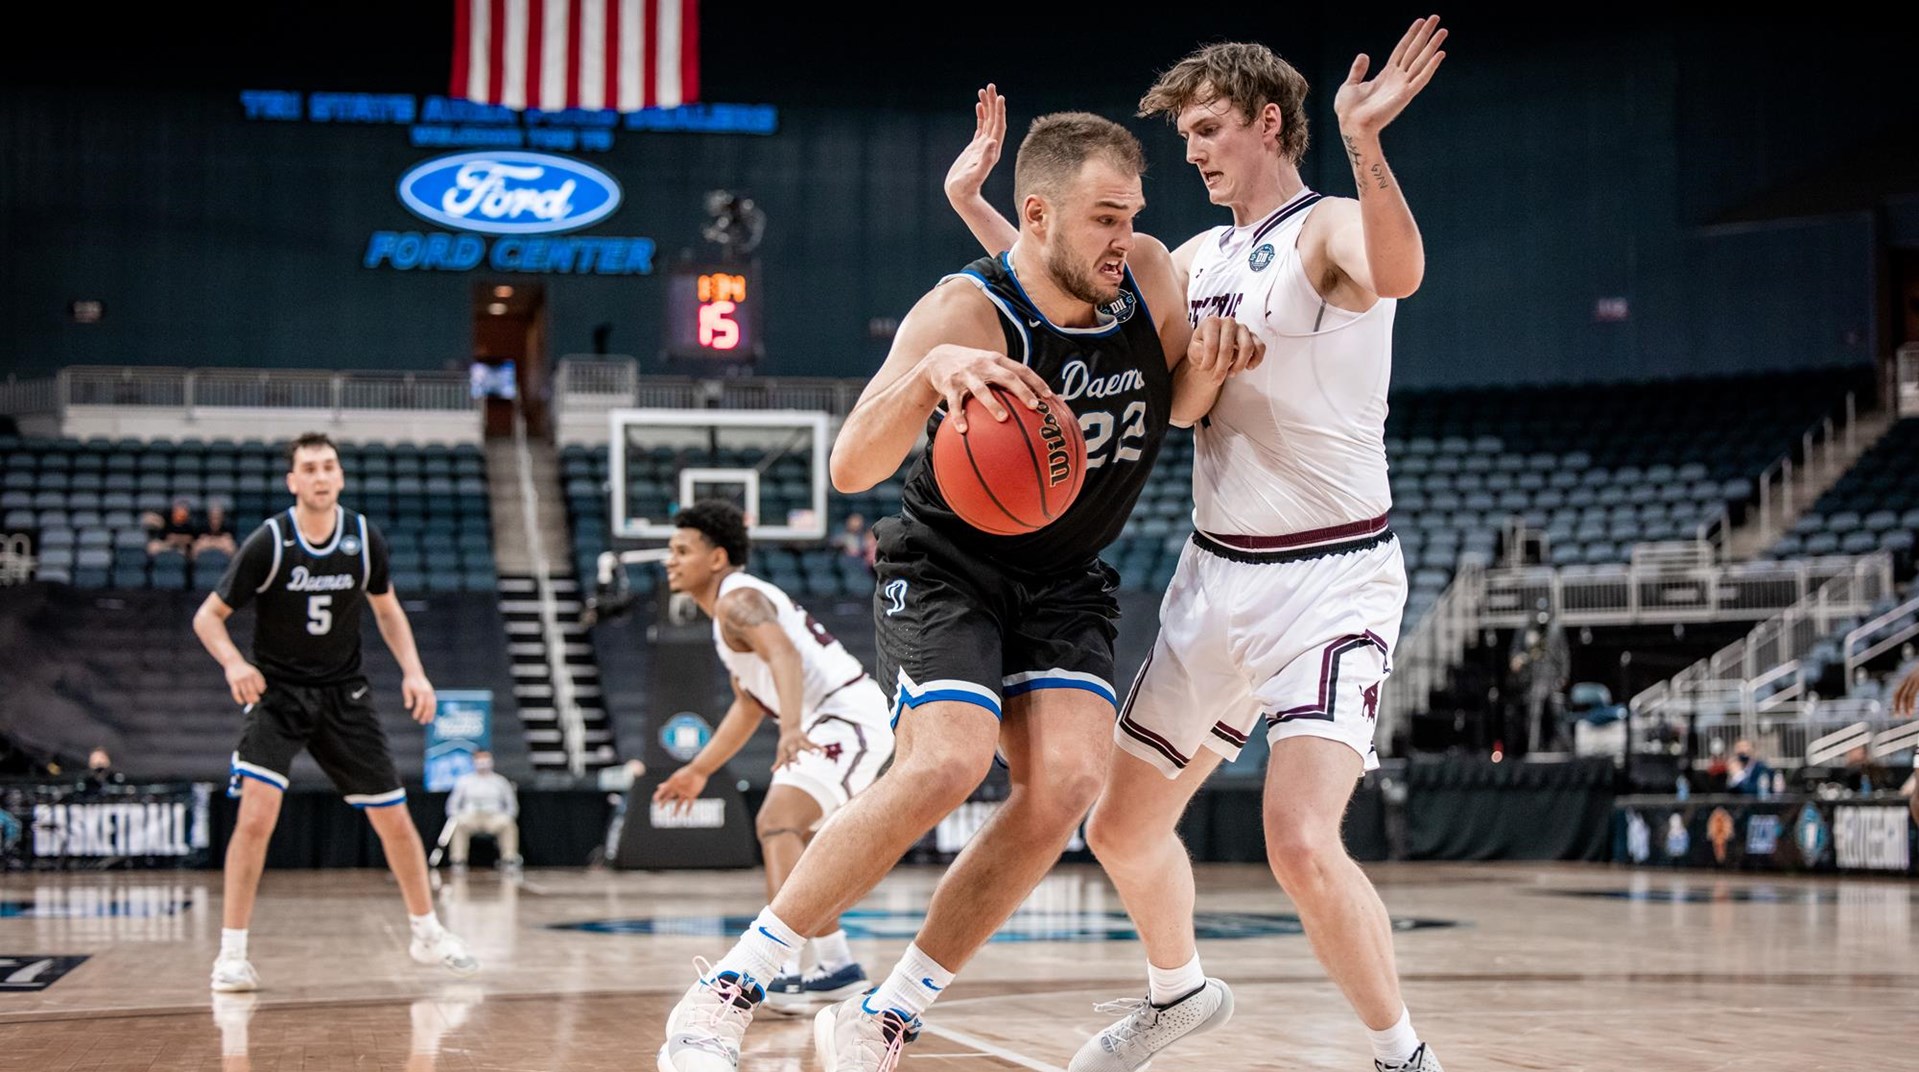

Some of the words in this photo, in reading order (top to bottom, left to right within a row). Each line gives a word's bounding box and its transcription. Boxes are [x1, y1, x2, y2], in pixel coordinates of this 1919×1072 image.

[443, 161, 576, 220] Ford
[363, 231, 486, 270] FORD
[489, 235, 656, 274] CENTER
[699, 301, 740, 349] 15
[1035, 398, 1071, 488] Wilso
[1078, 401, 1147, 468] 22
[286, 566, 355, 591] Daemen
[306, 595, 333, 636] 5
[33, 803, 190, 856] BASKETBALL
